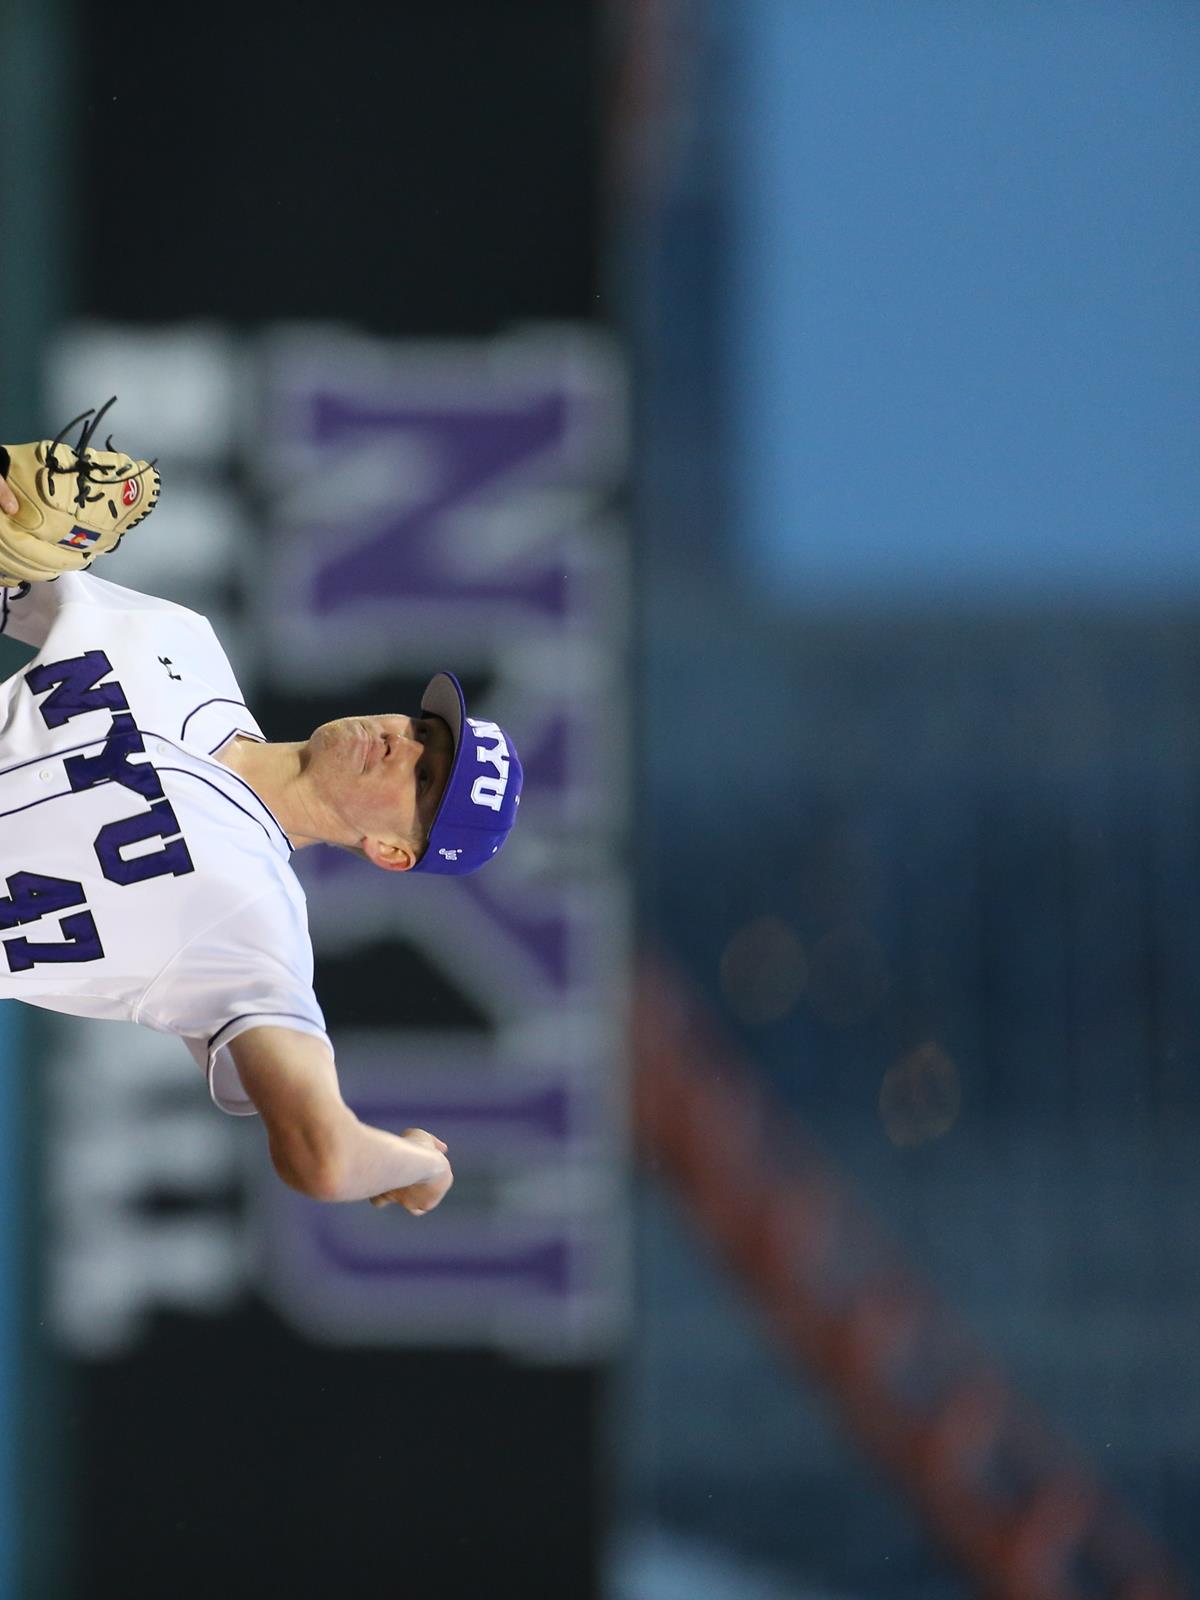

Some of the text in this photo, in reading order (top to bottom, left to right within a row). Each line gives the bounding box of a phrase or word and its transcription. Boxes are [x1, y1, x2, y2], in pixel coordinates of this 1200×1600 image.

[24, 649, 195, 887] NYU
[262, 325, 632, 1365] NYU
[466, 718, 510, 812] NYU
